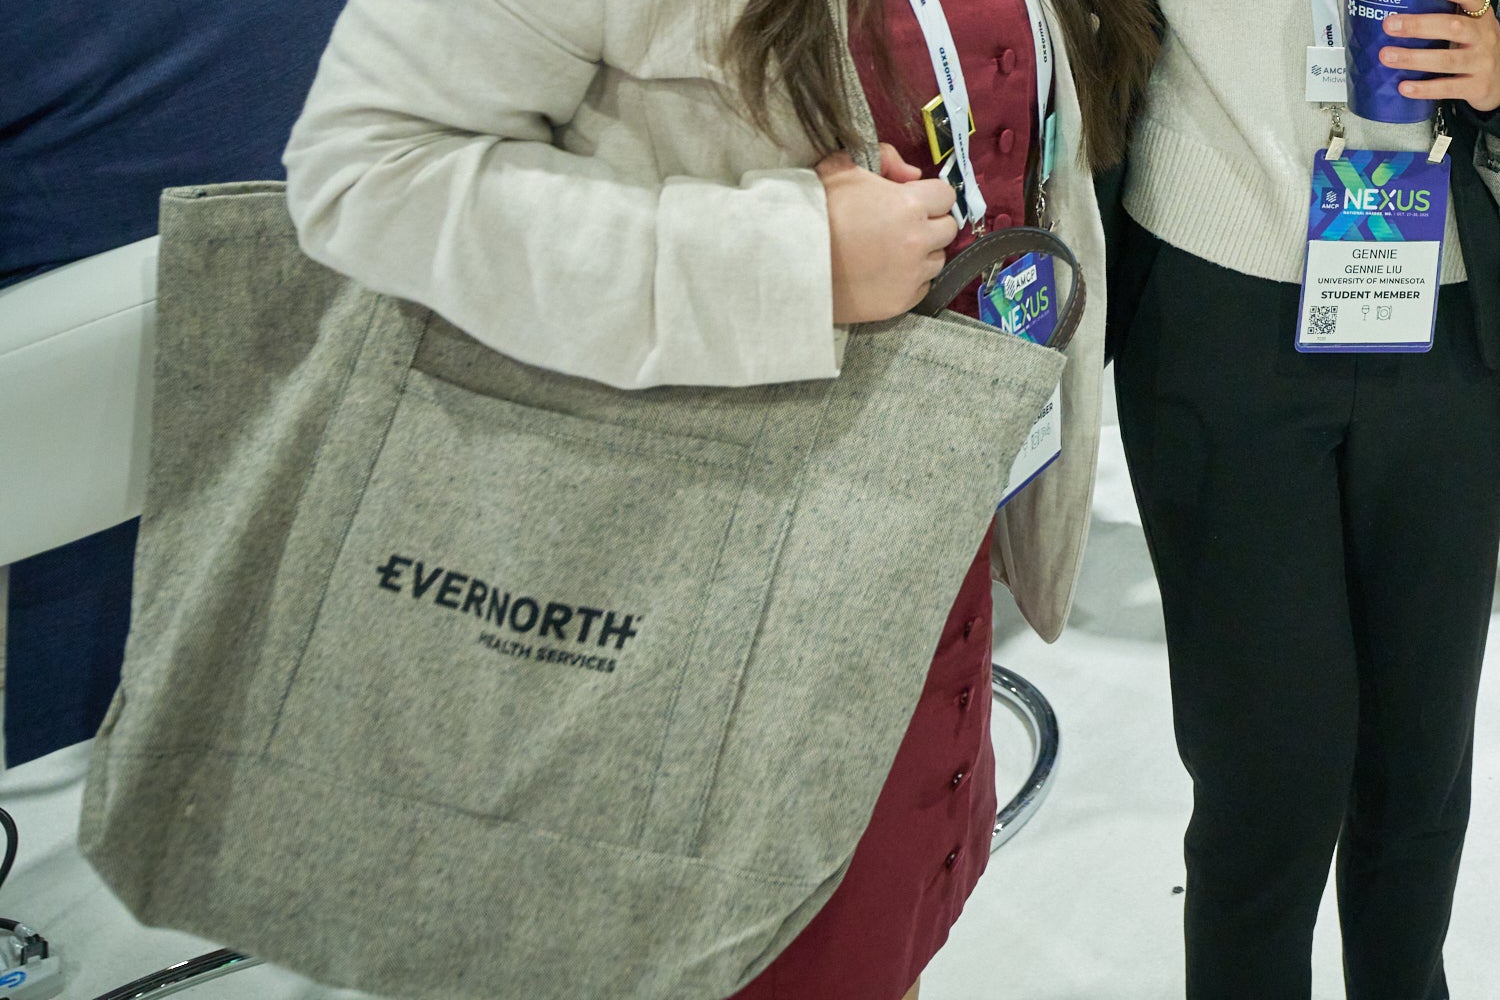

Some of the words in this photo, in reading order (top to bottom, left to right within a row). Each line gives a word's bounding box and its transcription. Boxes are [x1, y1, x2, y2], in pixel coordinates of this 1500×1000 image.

[1038, 21, 1048, 63] axsome
[939, 47, 954, 92] axsome
[1343, 188, 1431, 212] NEXUS
[1344, 265, 1384, 274] GENNIE
[1386, 265, 1403, 274] LIU
[1352, 249, 1398, 259] GENNIE
[1016, 269, 1035, 288] AMCP
[1321, 291, 1371, 299] STUDENT
[1373, 291, 1420, 299] MEMBER
[1001, 286, 1049, 334] NEXUS
[376, 553, 638, 650] EVERNORTH
[478, 630, 532, 659] HEALTH
[535, 647, 617, 674] SERVICES
